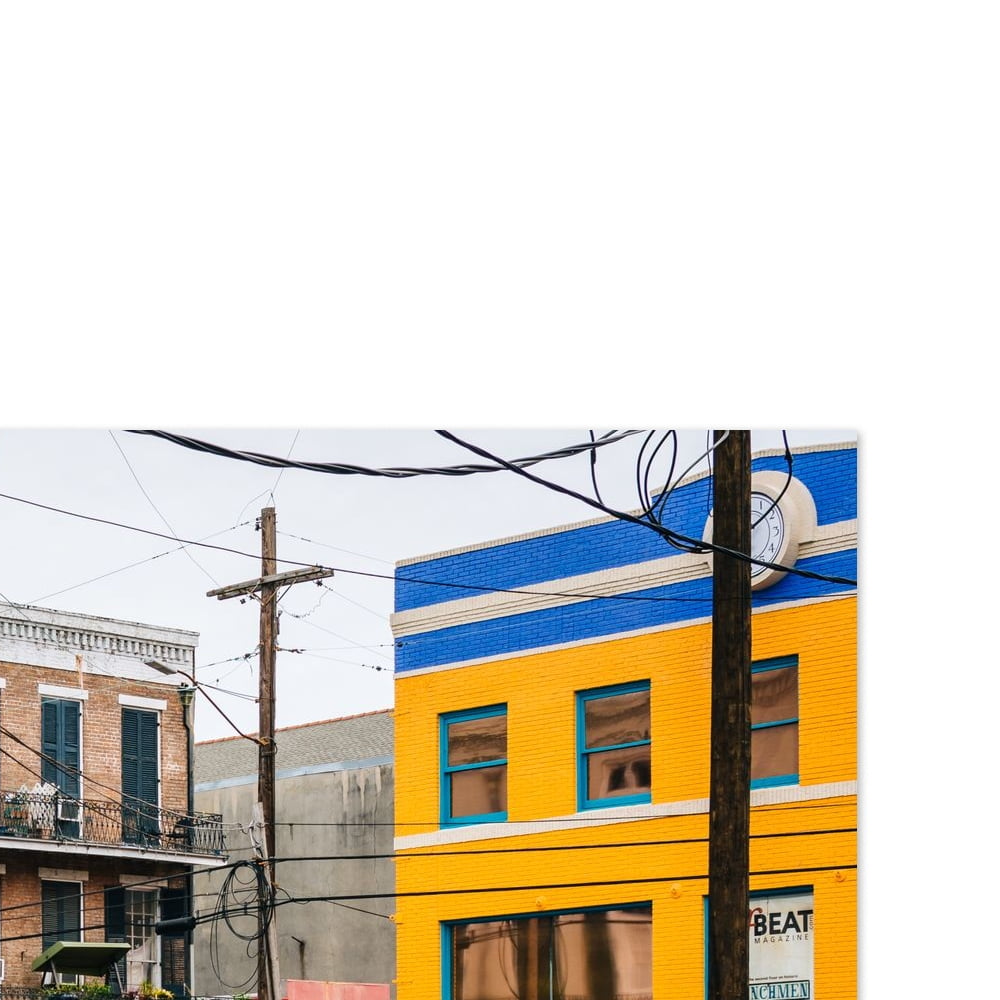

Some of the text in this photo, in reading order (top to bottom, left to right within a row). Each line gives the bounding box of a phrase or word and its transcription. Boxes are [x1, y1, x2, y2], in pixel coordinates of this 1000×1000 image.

[769, 509, 775, 520] 2
[773, 526, 780, 537] 3
[768, 542, 775, 553] 4
[754, 933, 809, 944] MAGAZINE
